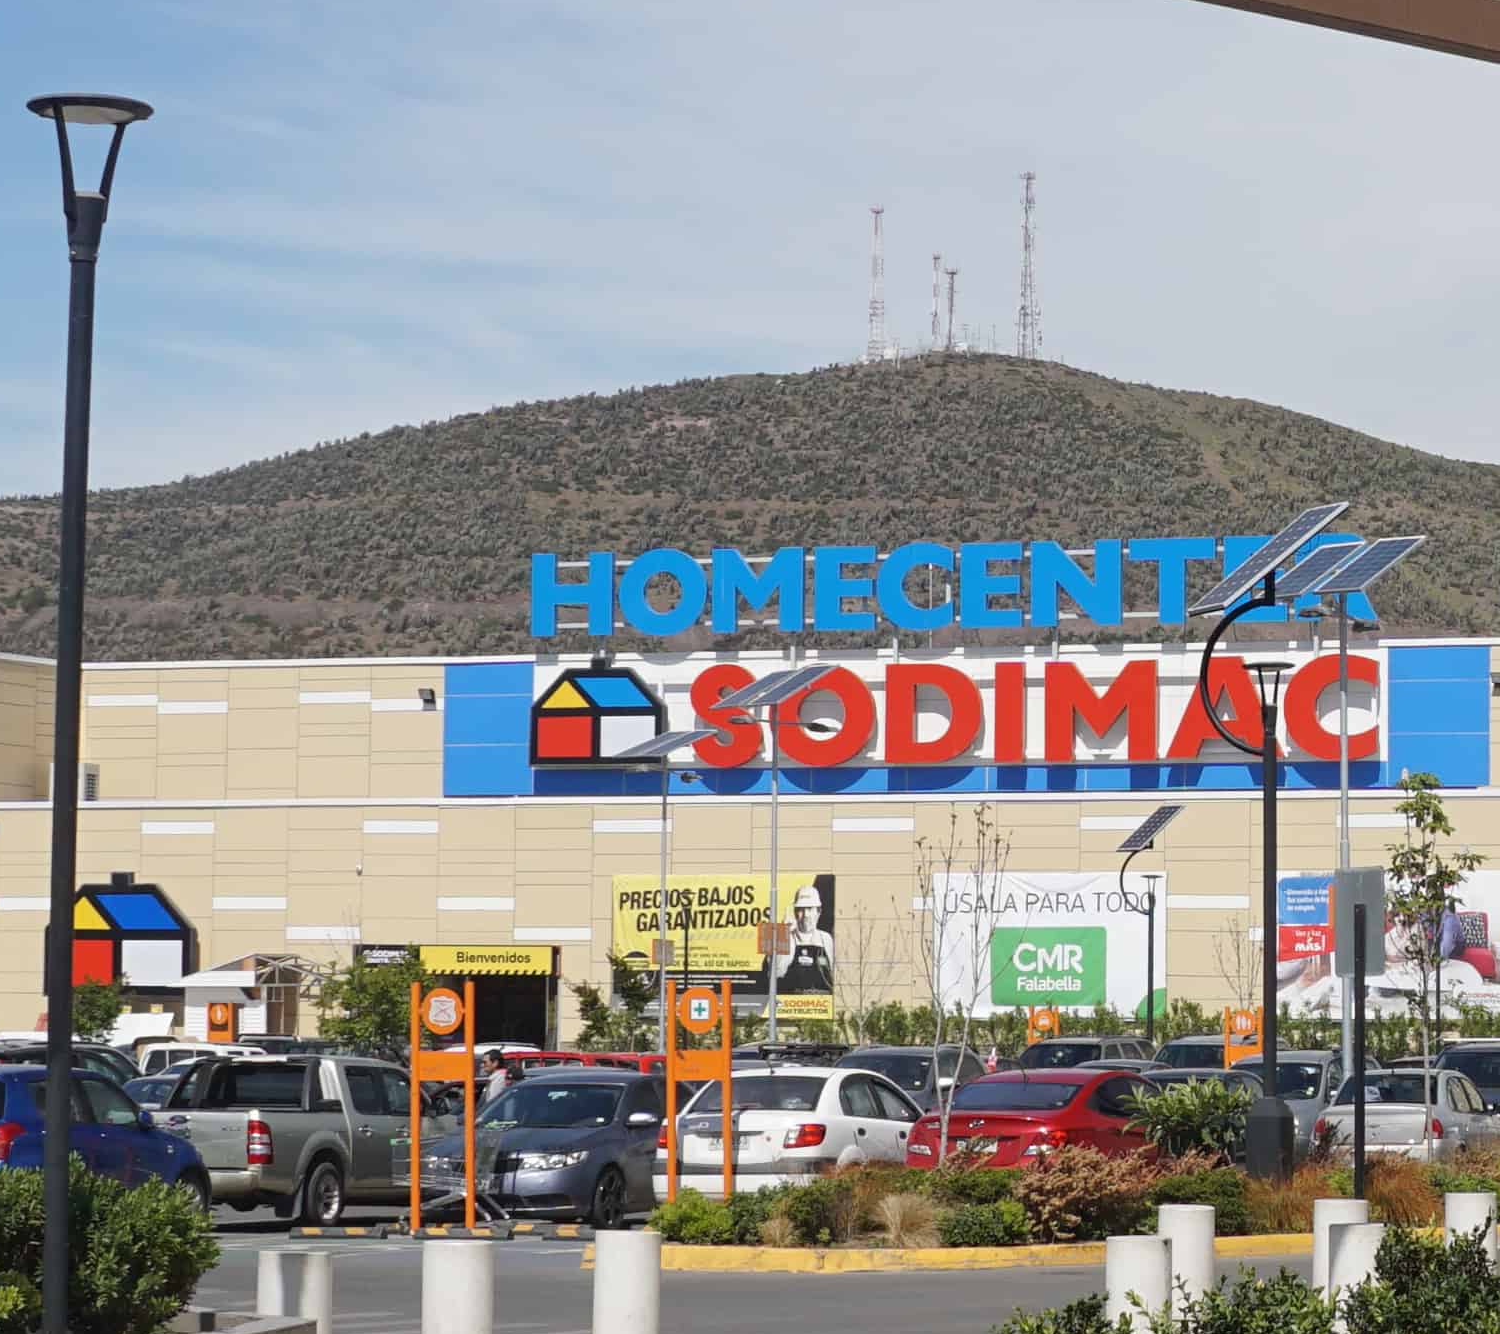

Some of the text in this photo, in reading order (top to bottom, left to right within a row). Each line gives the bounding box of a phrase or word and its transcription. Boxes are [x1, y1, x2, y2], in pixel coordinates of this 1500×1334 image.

[689, 654, 1380, 769] SODIMAC
[619, 885, 754, 910] PRECIOS BAJOS
[1025, 892, 1085, 913] PARA
[1092, 892, 1156, 913] TODO
[636, 907, 773, 932] GARANTIZADOS
[456, 951, 531, 964] Bienvenidos
[1013, 943, 1084, 974] CMR
[1016, 976, 1082, 992] Falabella
